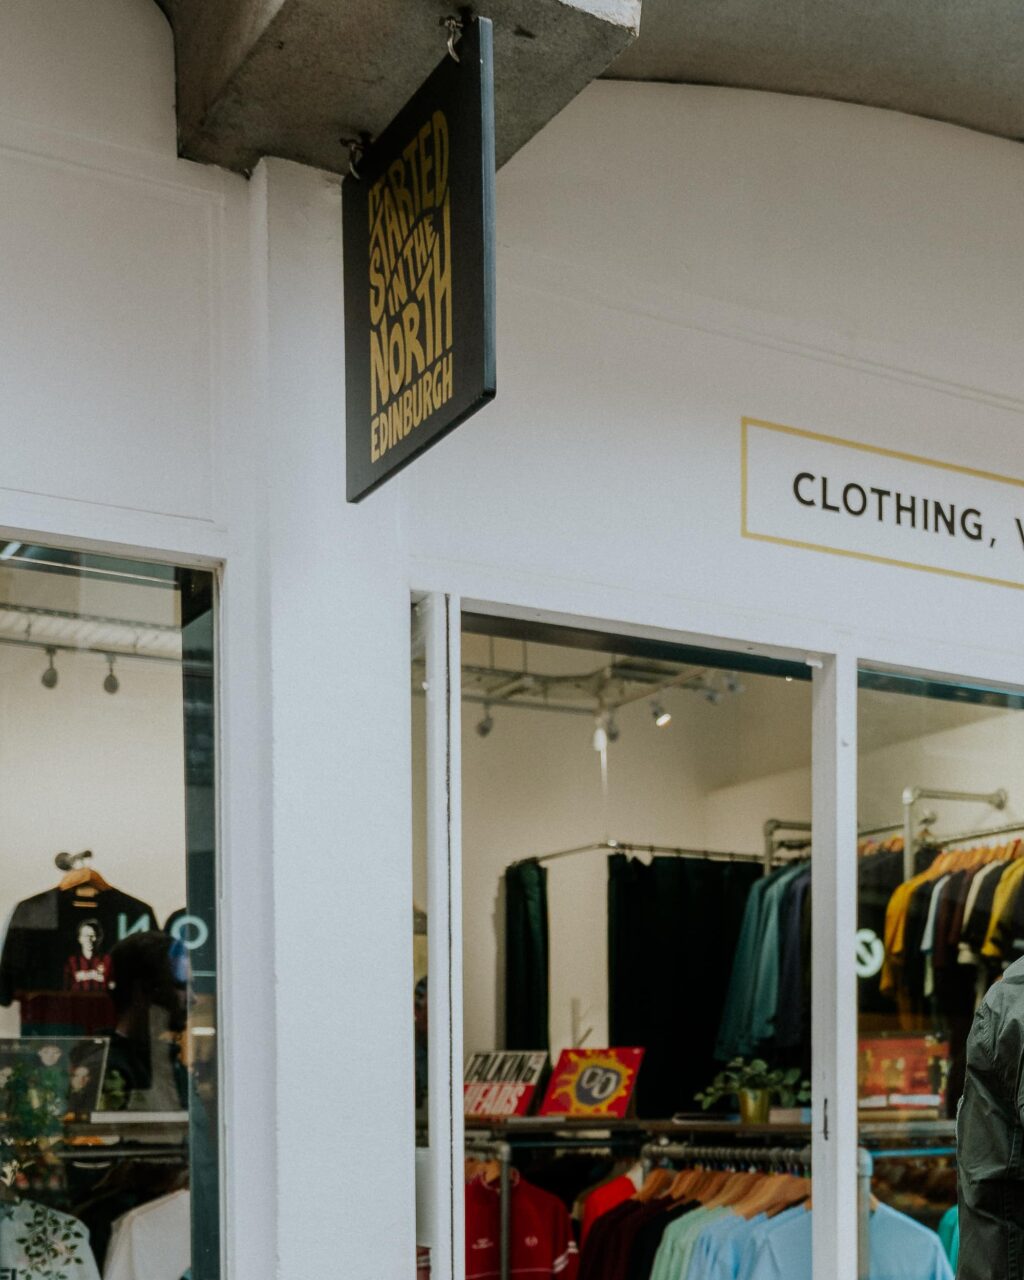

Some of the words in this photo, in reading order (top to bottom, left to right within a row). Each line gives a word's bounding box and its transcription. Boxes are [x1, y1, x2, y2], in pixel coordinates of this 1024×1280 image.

[369, 110, 449, 326] STARTED
[388, 256, 408, 316] IN
[403, 213, 436, 291] THE
[370, 187, 452, 416] NORTH
[371, 352, 452, 464] EDINBURGH
[792, 471, 997, 548] CLOTHING,
